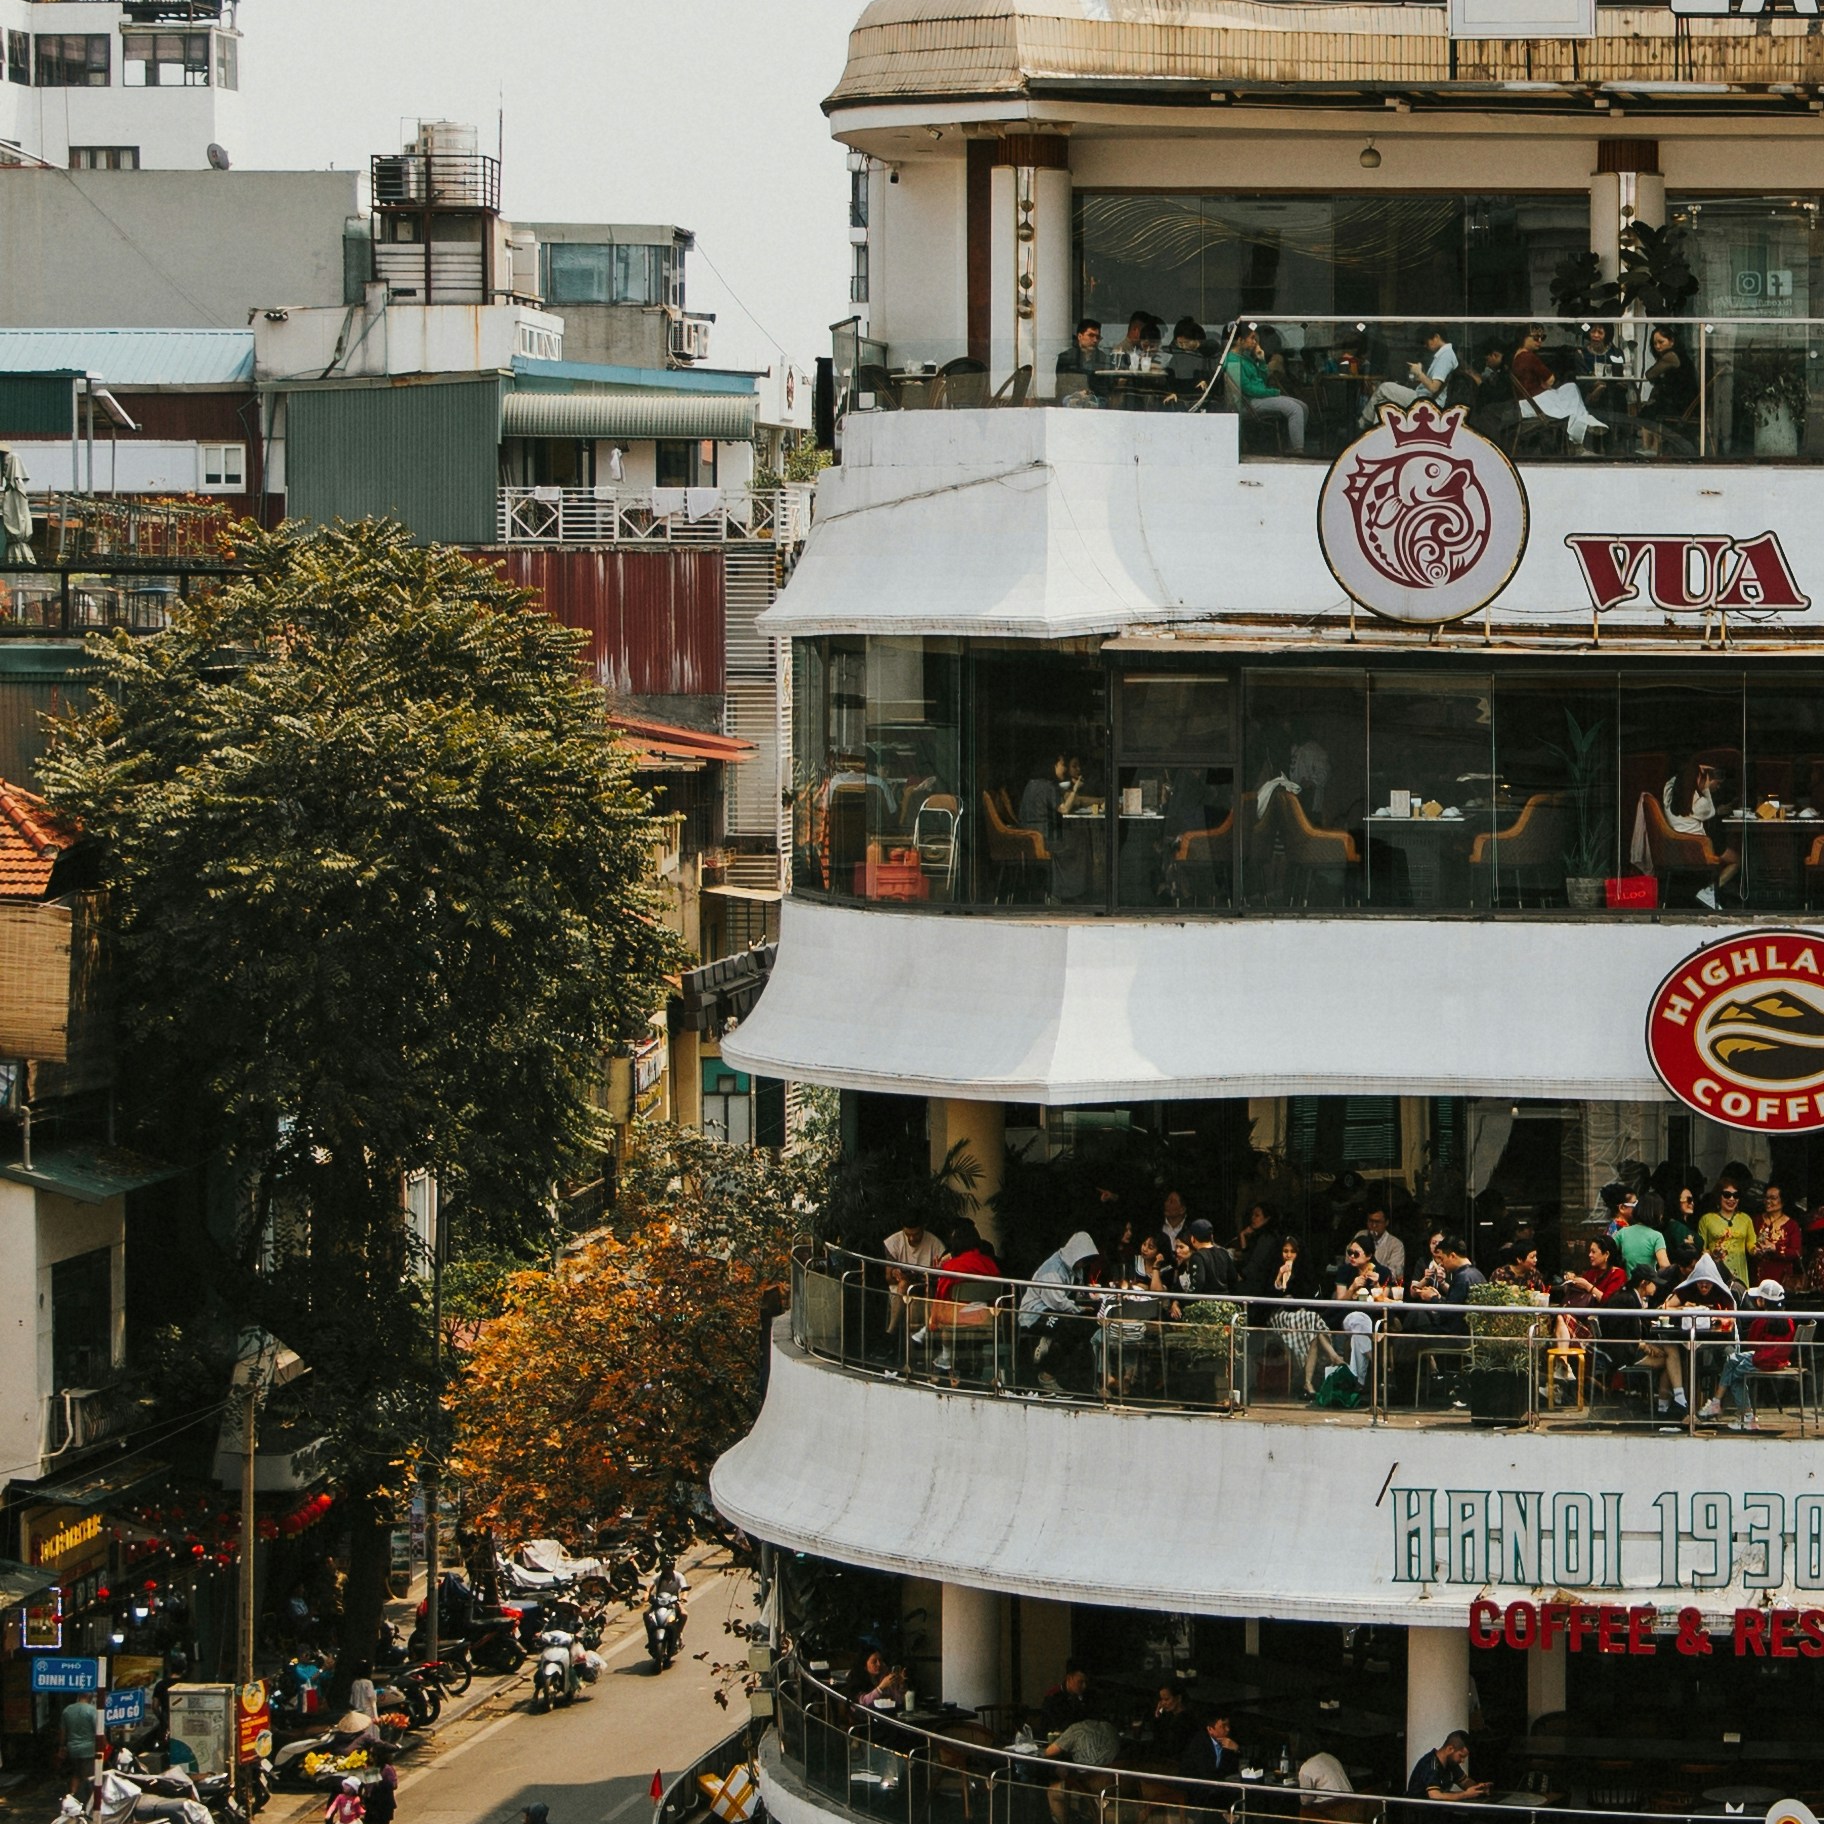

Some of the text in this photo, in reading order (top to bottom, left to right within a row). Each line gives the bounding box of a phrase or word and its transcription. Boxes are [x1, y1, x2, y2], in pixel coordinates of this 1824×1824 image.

[1563, 529, 1812, 612] VUA
[1390, 1488, 1624, 1588] HANOI
[1468, 1599, 1657, 1654] COFFEE
[1676, 1605, 1713, 1655] &
